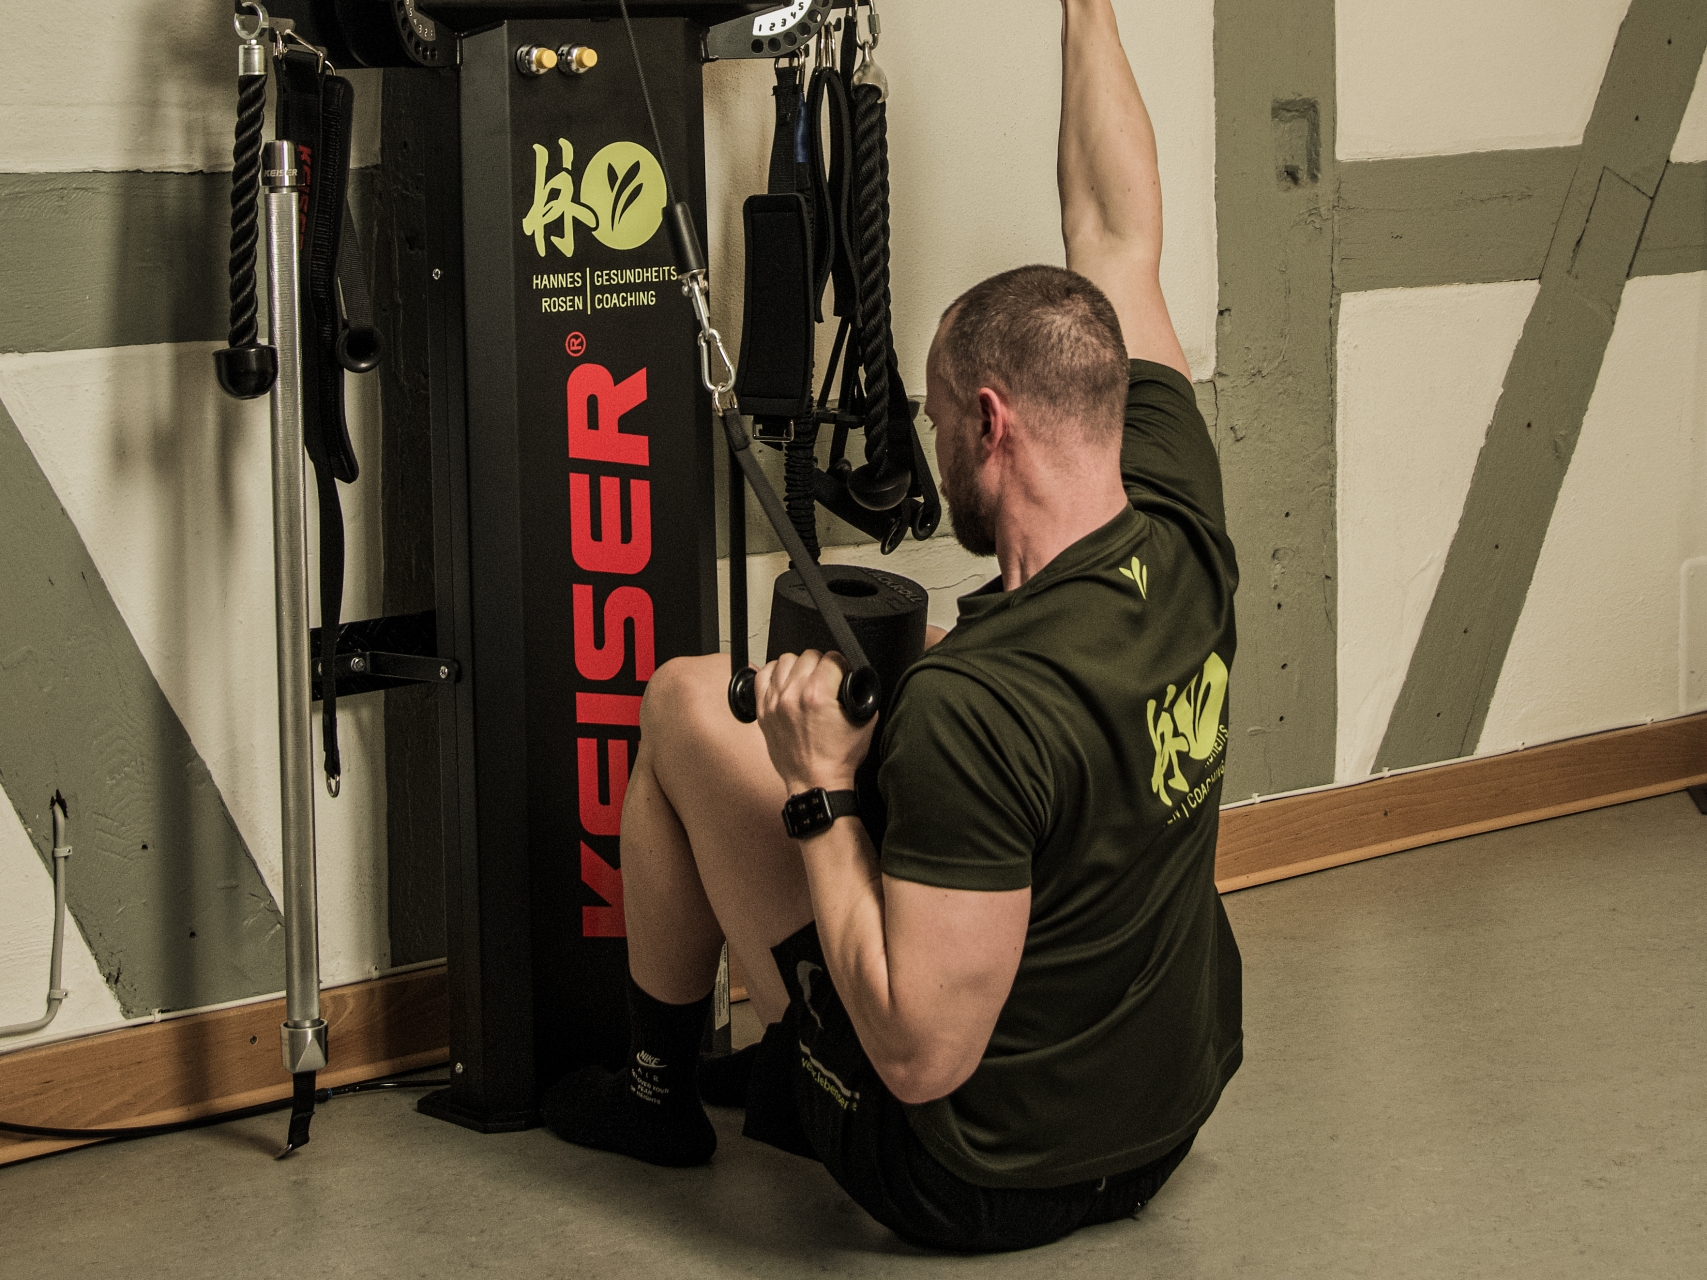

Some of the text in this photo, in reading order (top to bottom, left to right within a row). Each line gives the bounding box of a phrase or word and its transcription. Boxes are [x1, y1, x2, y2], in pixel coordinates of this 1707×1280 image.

[759, 24, 762, 32] 1
[769, 22, 775, 31] 2
[781, 18, 786, 27] 3
[798, 2, 804, 10] 5
[264, 169, 297, 177] KEISER
[533, 272, 582, 289] HANNES
[594, 266, 678, 285] GESUNDHEITS
[542, 296, 583, 313] ROSEN
[595, 291, 656, 309] COACHING
[640, 1050, 660, 1066] NIKE
[637, 1077, 651, 1089] OVER
[653, 1085, 669, 1093] YOUR
